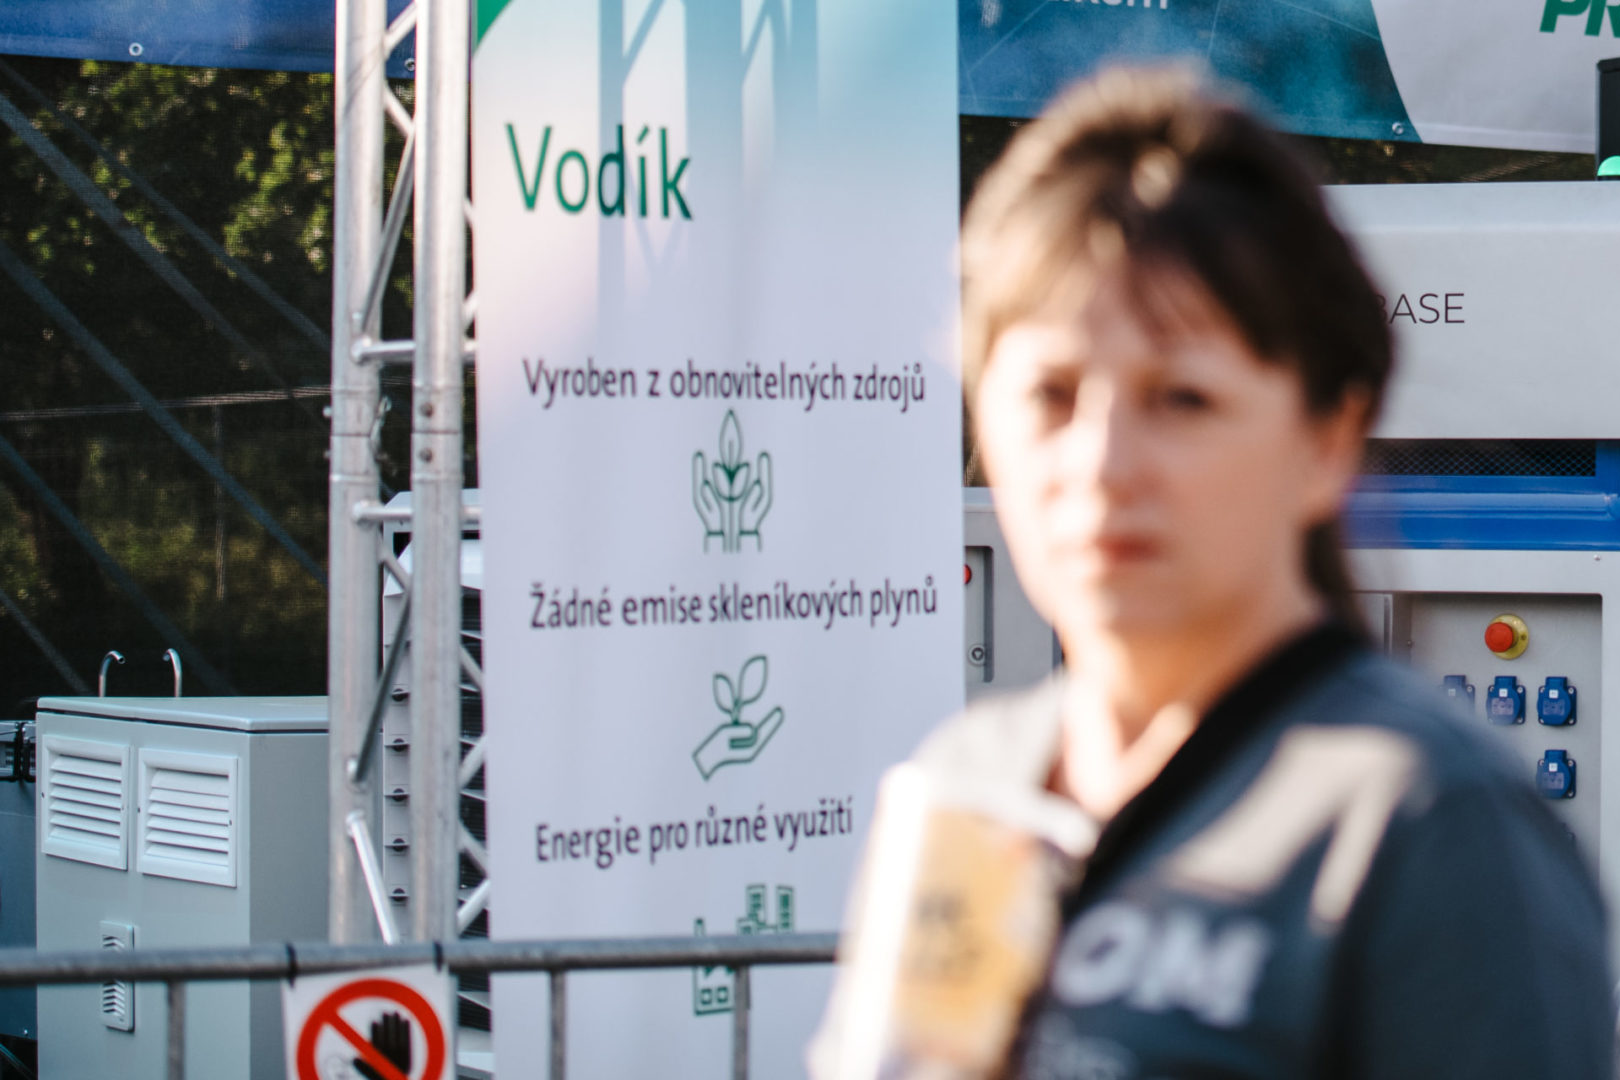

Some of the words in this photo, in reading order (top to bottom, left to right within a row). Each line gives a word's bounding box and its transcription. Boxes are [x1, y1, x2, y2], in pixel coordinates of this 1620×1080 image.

[506, 122, 693, 220] Vodík
[523, 357, 636, 409] Vyroben
[647, 370, 660, 398] z
[670, 358, 846, 412] obnovitelných
[853, 362, 925, 413] zdrojů
[530, 581, 612, 629] Žádné
[621, 584, 703, 626] emise
[708, 579, 863, 631] skleníkových
[869, 574, 938, 628] plynů
[536, 815, 641, 870] Energie
[649, 820, 689, 866] pro
[695, 803, 768, 848] různé
[773, 796, 853, 853] využití
